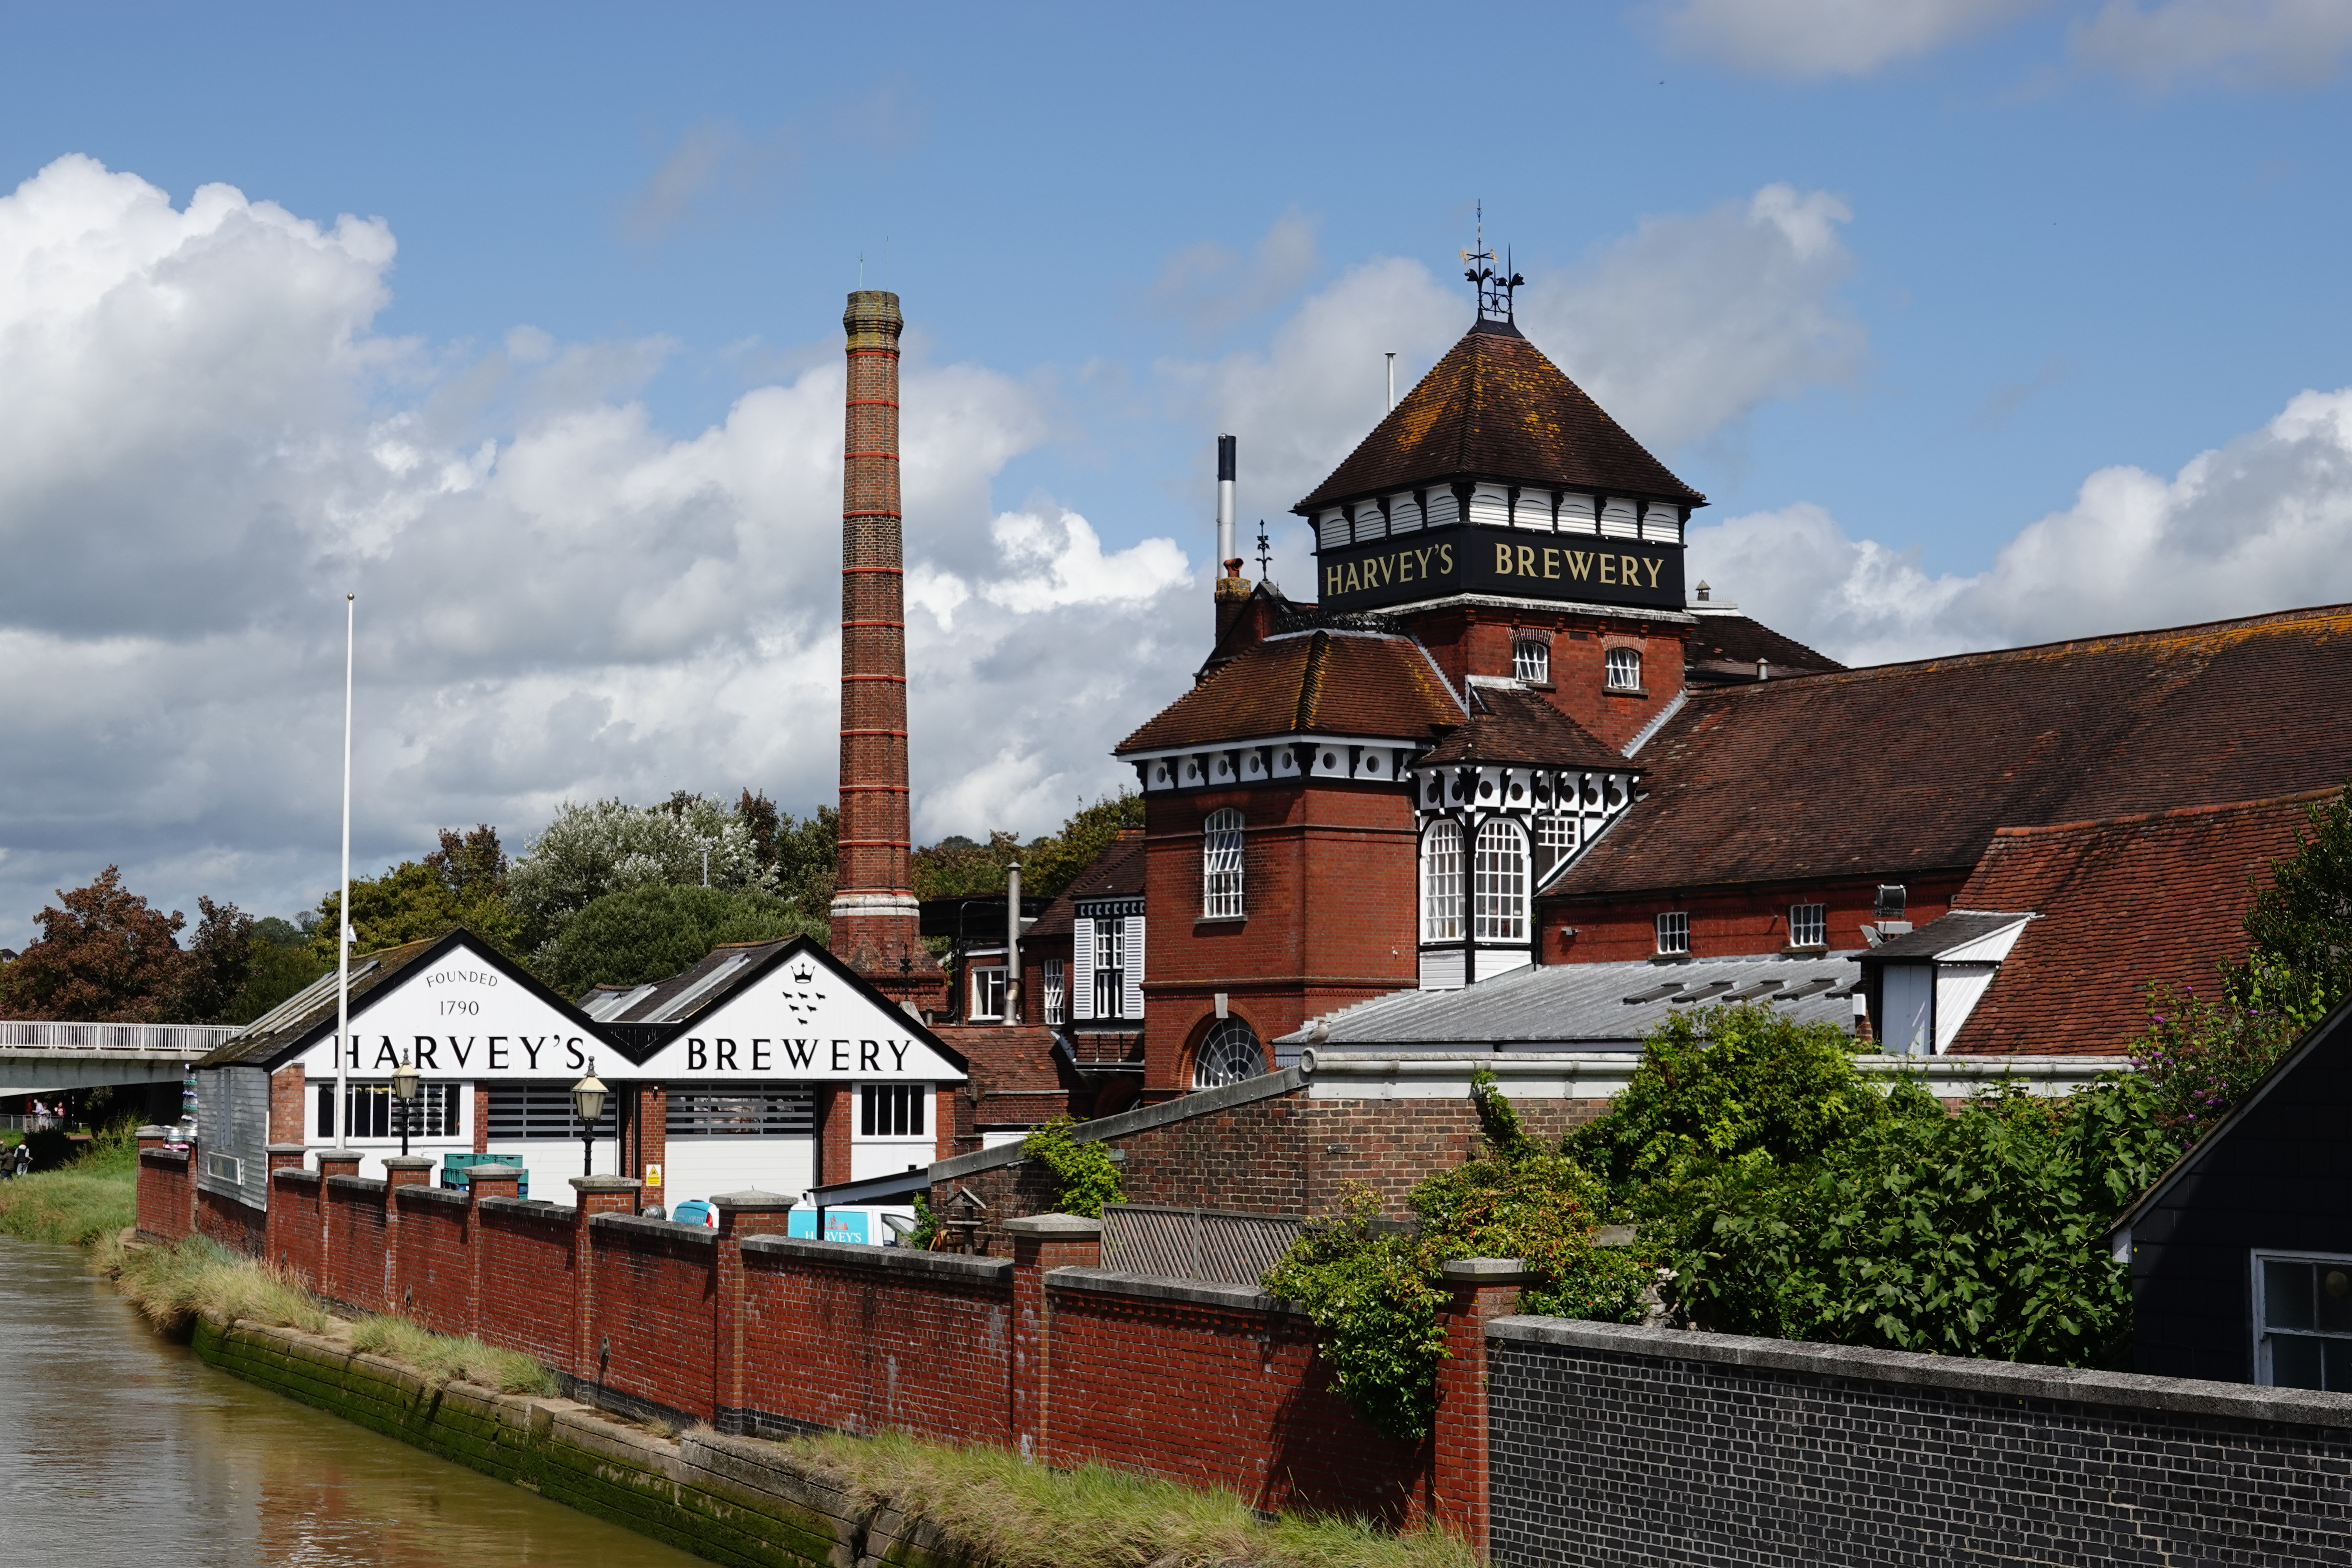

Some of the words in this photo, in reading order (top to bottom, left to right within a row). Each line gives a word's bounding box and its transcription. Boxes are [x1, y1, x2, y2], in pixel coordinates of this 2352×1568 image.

[1326, 543, 1453, 597] HARVEY'S
[1494, 542, 1665, 588] BREWERY
[426, 970, 498, 988] FOUNDED
[440, 1000, 479, 1016] 1790
[332, 1034, 585, 1070] HARVEY'S
[686, 1038, 911, 1072] BREWERY
[805, 1231, 861, 1243] HRVEY'S
